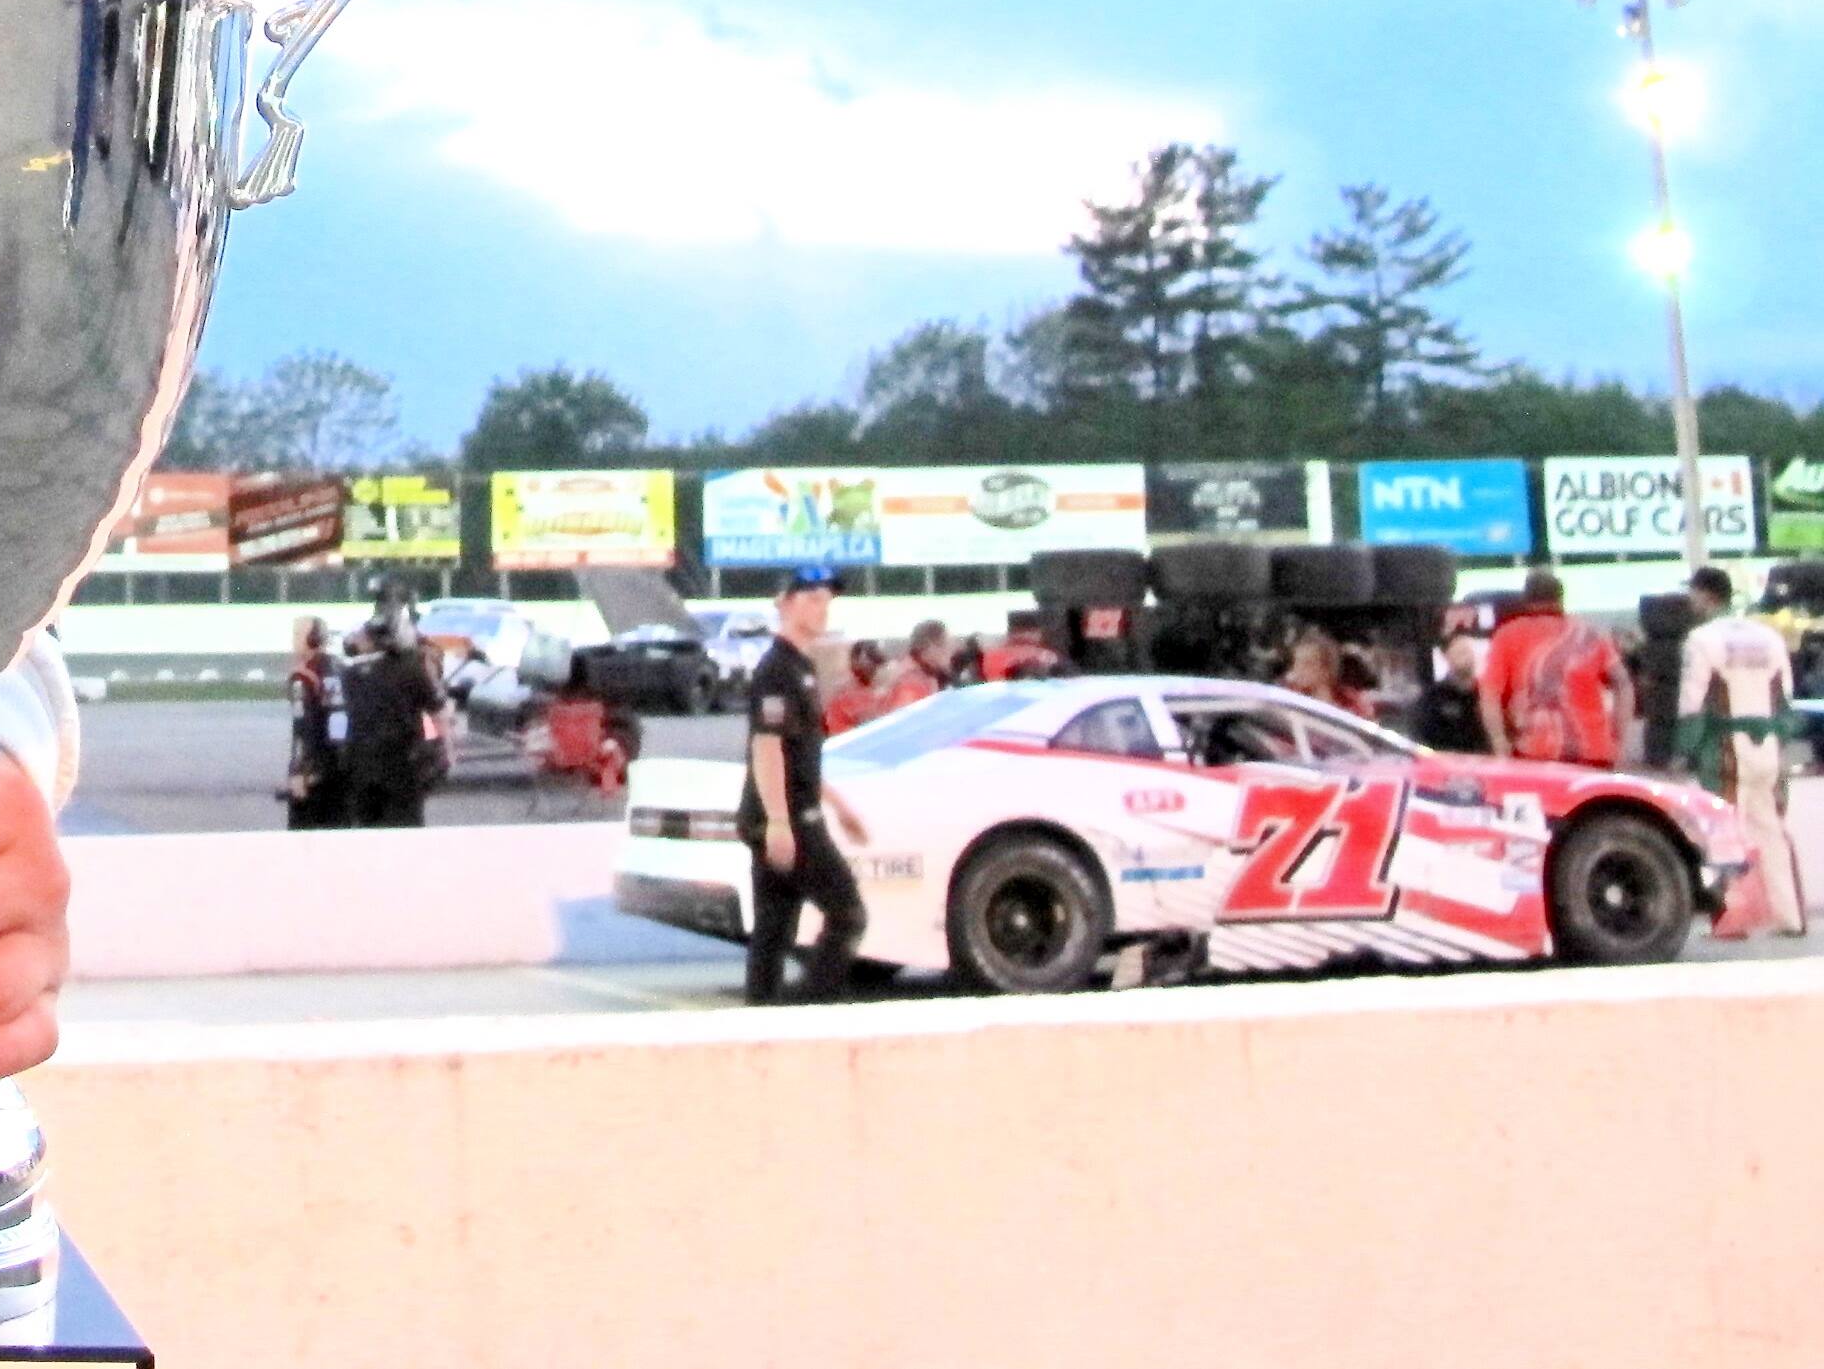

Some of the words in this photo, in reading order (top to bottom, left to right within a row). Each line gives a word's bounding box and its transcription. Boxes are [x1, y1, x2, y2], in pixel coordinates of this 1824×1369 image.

[1371, 474, 1463, 513] NTN
[1555, 470, 1685, 501] ALBION
[1555, 506, 1640, 538] GOLF
[1651, 503, 1748, 536] CRS
[1216, 774, 1410, 923] 71
